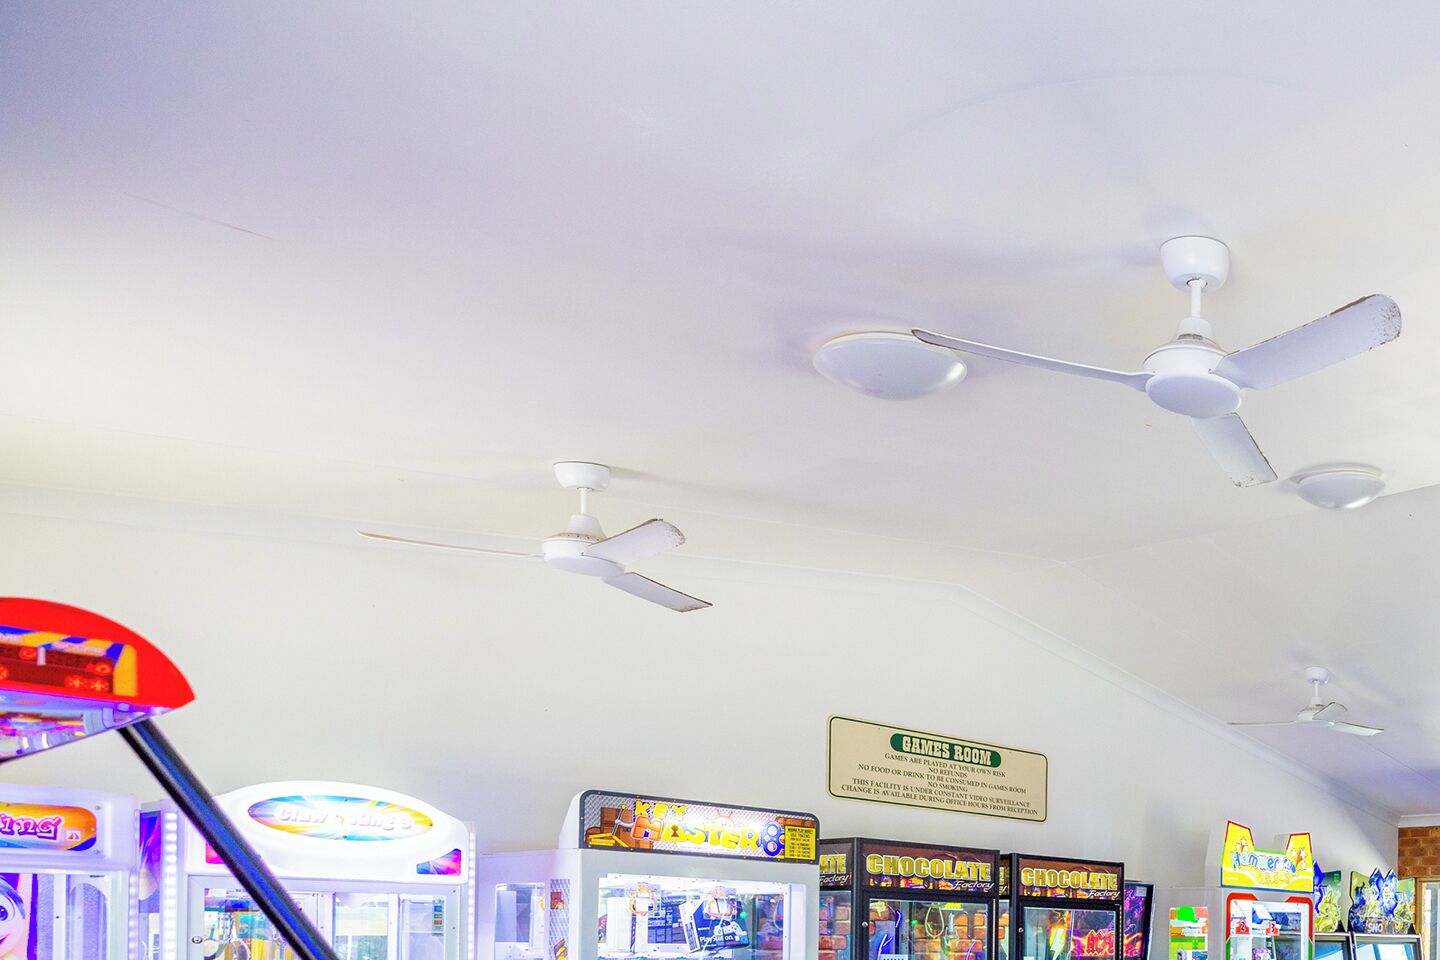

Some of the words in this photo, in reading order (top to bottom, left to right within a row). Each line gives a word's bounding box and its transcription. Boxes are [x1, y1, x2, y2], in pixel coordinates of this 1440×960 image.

[902, 736, 950, 759] GAMES
[954, 745, 991, 766] ROOM
[884, 753, 908, 763] GAMES
[910, 757, 922, 765] ARE
[923, 760, 947, 768] PLAYED
[959, 765, 975, 773] YOUR
[993, 770, 1006, 778] RISK
[940, 769, 968, 778] REFUNDS
[871, 765, 891, 774] FOOD
[903, 770, 925, 779] DRINK
[945, 776, 980, 787] CONSUMED
[989, 783, 1008, 792] GAMES
[1009, 786, 1027, 794] ROOM
[938, 783, 968, 793] SMOKING
[841, 784, 872, 794] CHANGE
[881, 789, 917, 800] AVAILABLE
[919, 794, 945, 803] DURING
[945, 797, 967, 806] OFFICE
[967, 800, 989, 809] HOURS
[989, 804, 1007, 812] FROM
[1007, 806, 1038, 815] RECEPTION
[852, 778, 869, 786] THIS
[870, 780, 901, 790] FACILITY
[910, 785, 934, 795] UNDER
[934, 790, 968, 800] CONSTANT
[969, 794, 988, 802] VIDEO
[989, 796, 1031, 808] SURVEILLANCE
[275, 805, 328, 824] Claw
[351, 811, 397, 831] King
[634, 800, 688, 818] KEY
[631, 815, 760, 850] MASTER
[866, 853, 992, 882] CHOCOLATE
[1021, 867, 1119, 890] CHOCOLATE
[953, 880, 995, 890] Factory
[1088, 890, 1121, 898] Factory
